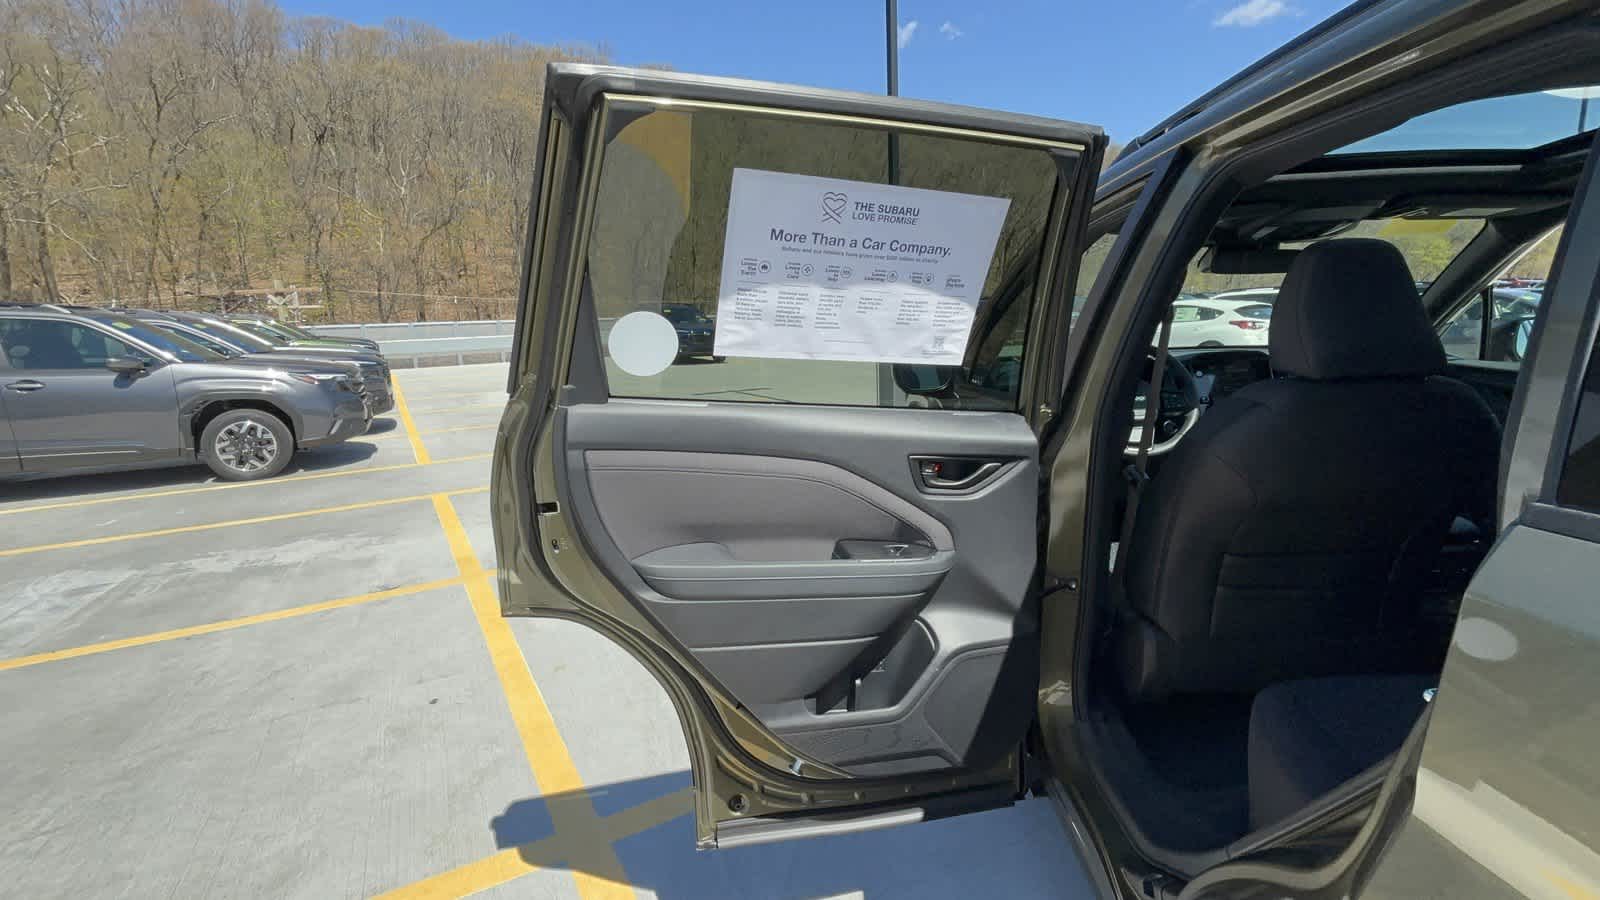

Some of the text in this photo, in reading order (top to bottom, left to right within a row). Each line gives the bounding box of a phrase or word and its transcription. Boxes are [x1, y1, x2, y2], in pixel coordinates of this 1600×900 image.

[854, 202, 920, 217] THE SUBARU
[852, 212, 919, 225] LOVE PROMISE
[770, 228, 952, 257] More Than a Car Company.
